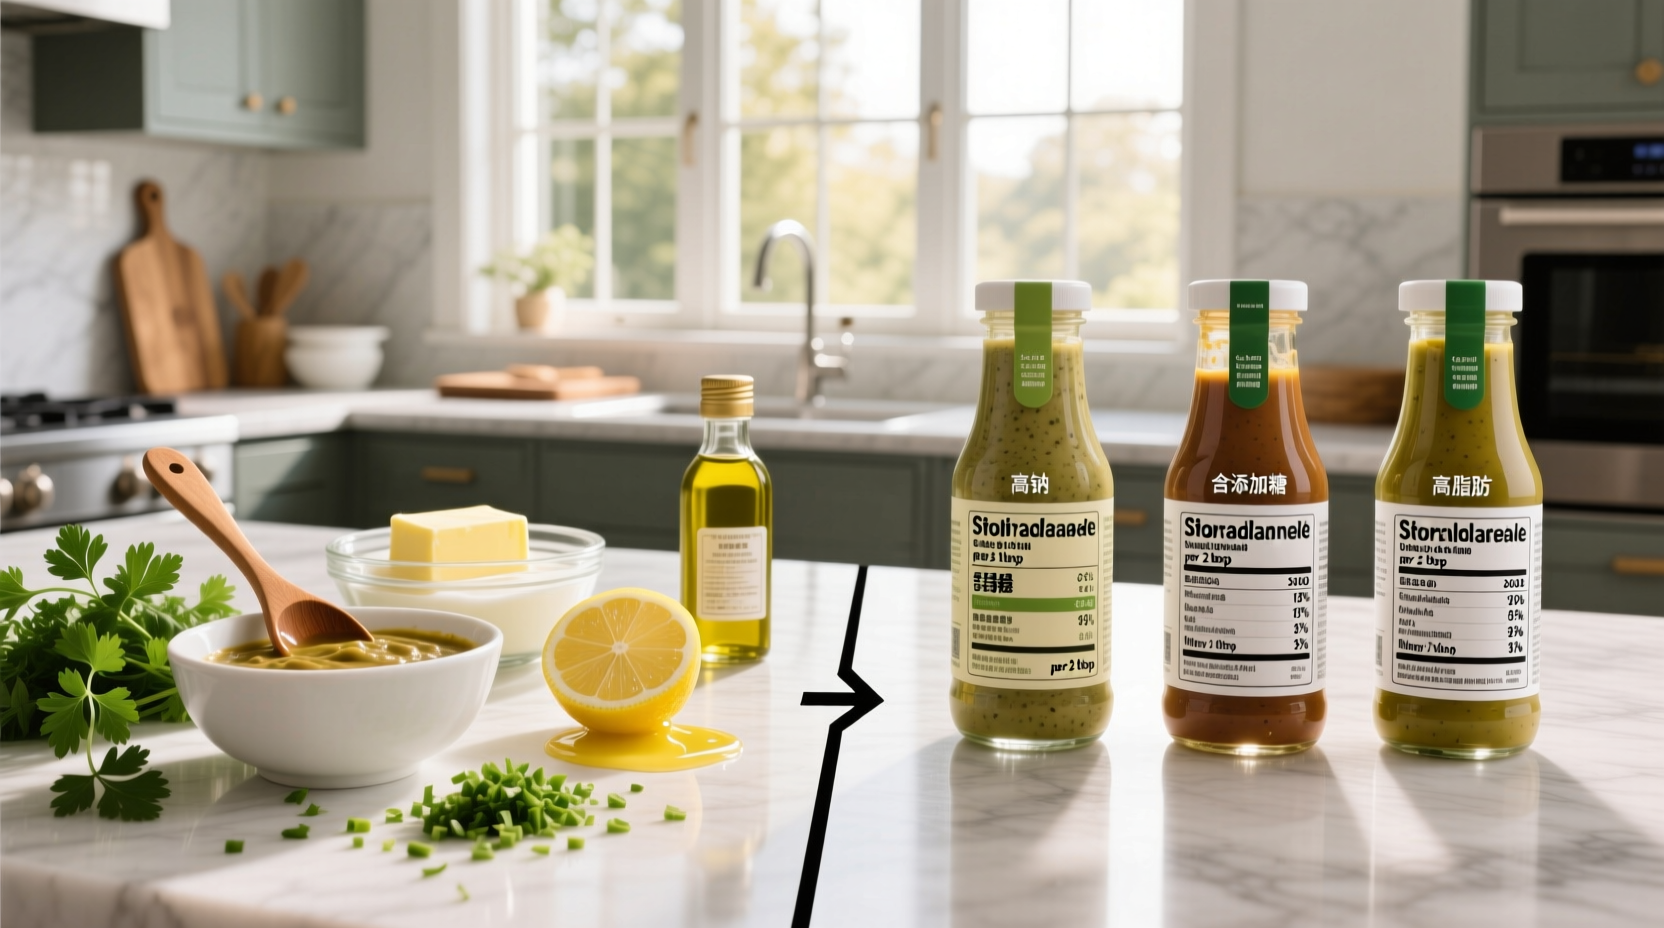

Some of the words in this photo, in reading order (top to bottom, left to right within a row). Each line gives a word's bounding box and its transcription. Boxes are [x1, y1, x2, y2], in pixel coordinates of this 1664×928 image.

[1011, 472, 1049, 495] 高钠
[1432, 474, 1493, 497] 高脂肪
[1069, 659, 1075, 672] 2
